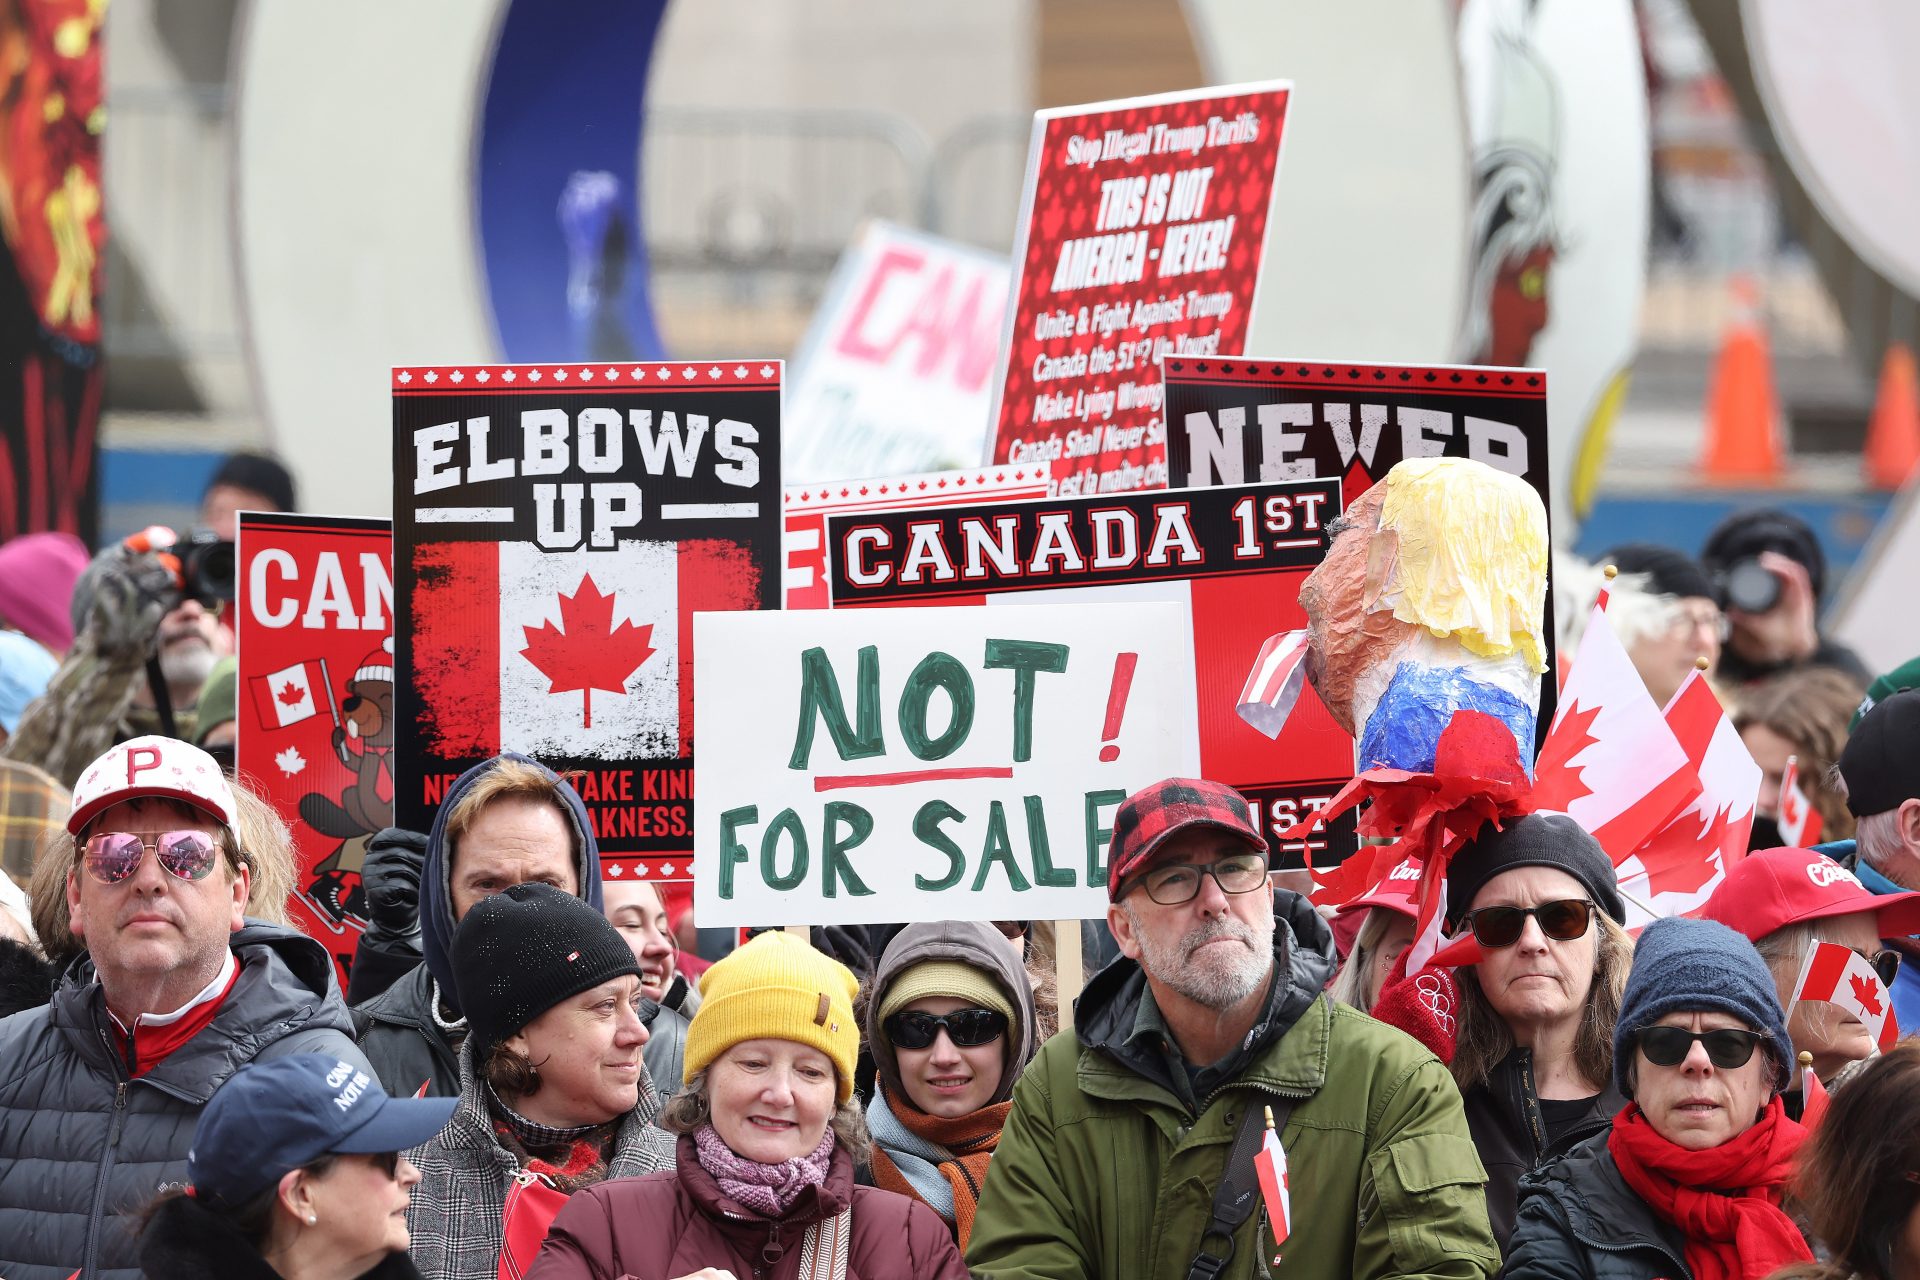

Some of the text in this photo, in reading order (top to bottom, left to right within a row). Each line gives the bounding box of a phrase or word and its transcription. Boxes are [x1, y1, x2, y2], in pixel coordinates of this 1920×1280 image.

[1153, 123, 1207, 155] Trump
[1096, 166, 1214, 232] THIS IS NOT
[1050, 230, 1149, 292] AMERICA
[1158, 214, 1237, 278] NEVER!
[1035, 290, 1234, 341] Unite & Fight Against Trump
[1033, 348, 1087, 382] Canada
[1089, 345, 1116, 375] the
[1032, 390, 1075, 424] Make
[1074, 386, 1115, 422] Lying
[414, 408, 760, 495] ELBOWS
[1008, 432, 1063, 465] Canada
[1063, 424, 1103, 459] Shall
[1102, 420, 1147, 454] Never
[533, 483, 643, 548] UP
[844, 502, 1204, 587] CANADA
[1232, 492, 1327, 559] 1ST
[788, 638, 1070, 770] NOT
[127, 747, 163, 785] P
[718, 789, 1126, 900] FOR SALE
